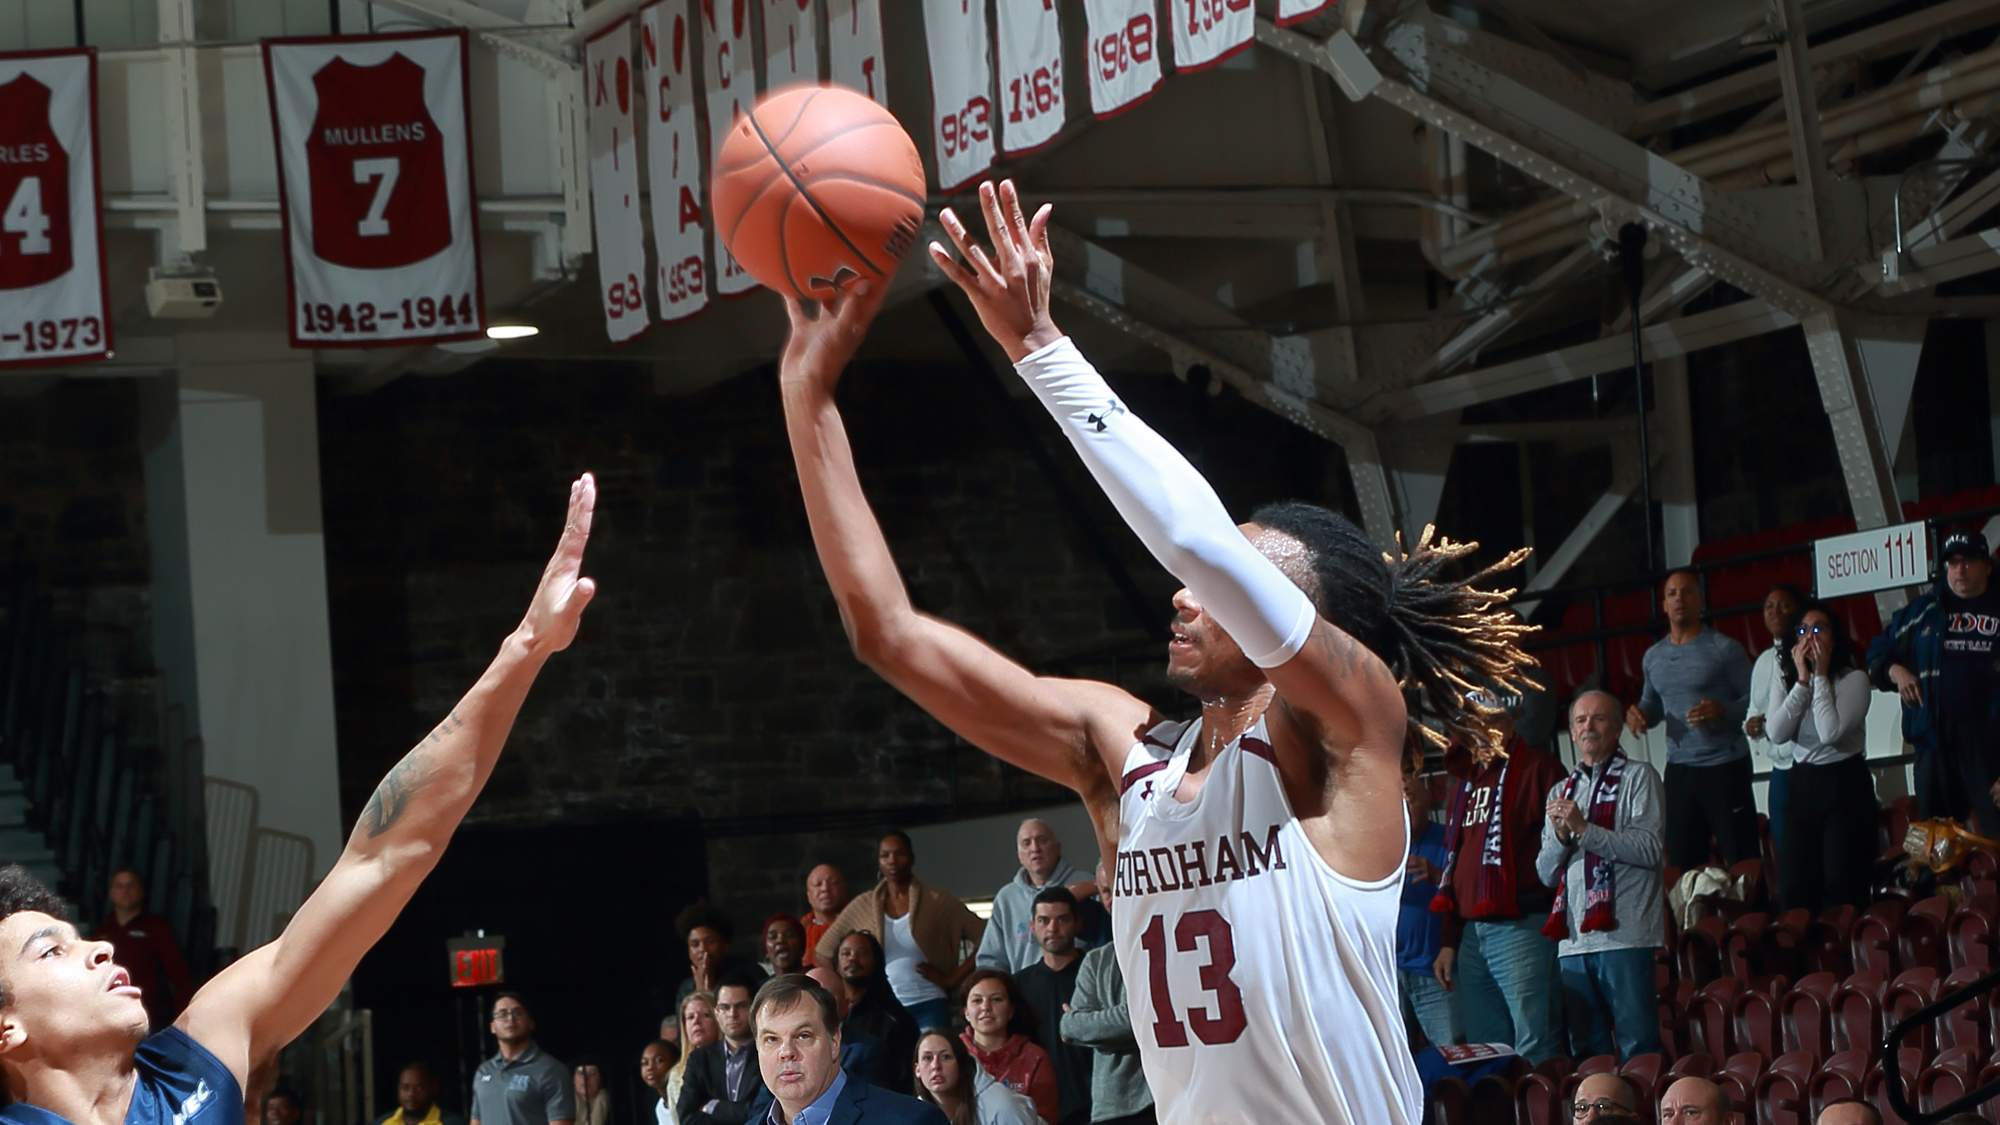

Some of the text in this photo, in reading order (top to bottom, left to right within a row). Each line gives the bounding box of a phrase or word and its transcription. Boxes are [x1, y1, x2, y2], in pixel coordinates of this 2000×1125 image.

[324, 122, 426, 145] MULLENS
[353, 157, 400, 237] 7
[303, 292, 472, 333] 1942-1944
[1828, 531, 1915, 580] SECTION 111
[456, 949, 498, 983] EXIT
[1141, 909, 1248, 1048] 13
